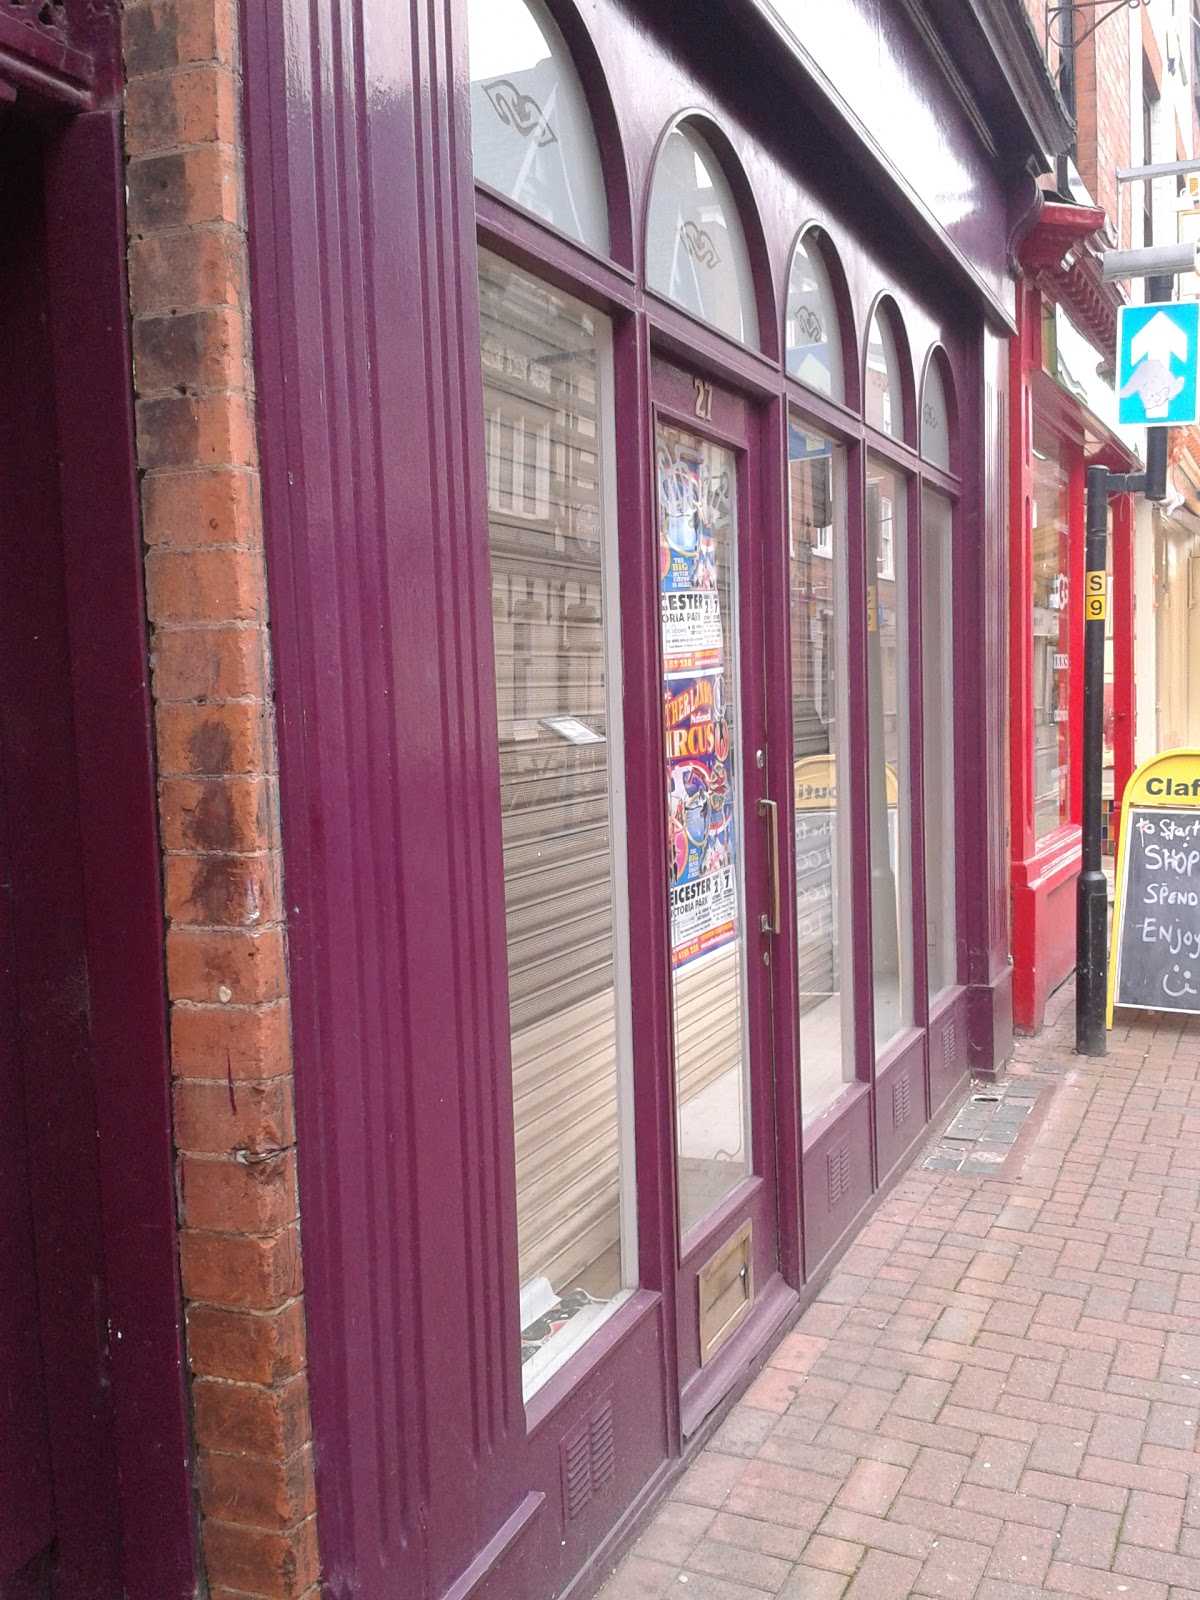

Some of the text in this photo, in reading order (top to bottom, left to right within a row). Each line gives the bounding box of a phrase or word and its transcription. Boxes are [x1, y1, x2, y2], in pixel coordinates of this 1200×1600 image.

[693, 377, 713, 421] 27
[1090, 575, 1102, 591] S
[1090, 600, 1102, 616] 9
[1146, 777, 1200, 796] Claf
[1145, 845, 1200, 876] SHOP
[1143, 883, 1198, 906] SPEND
